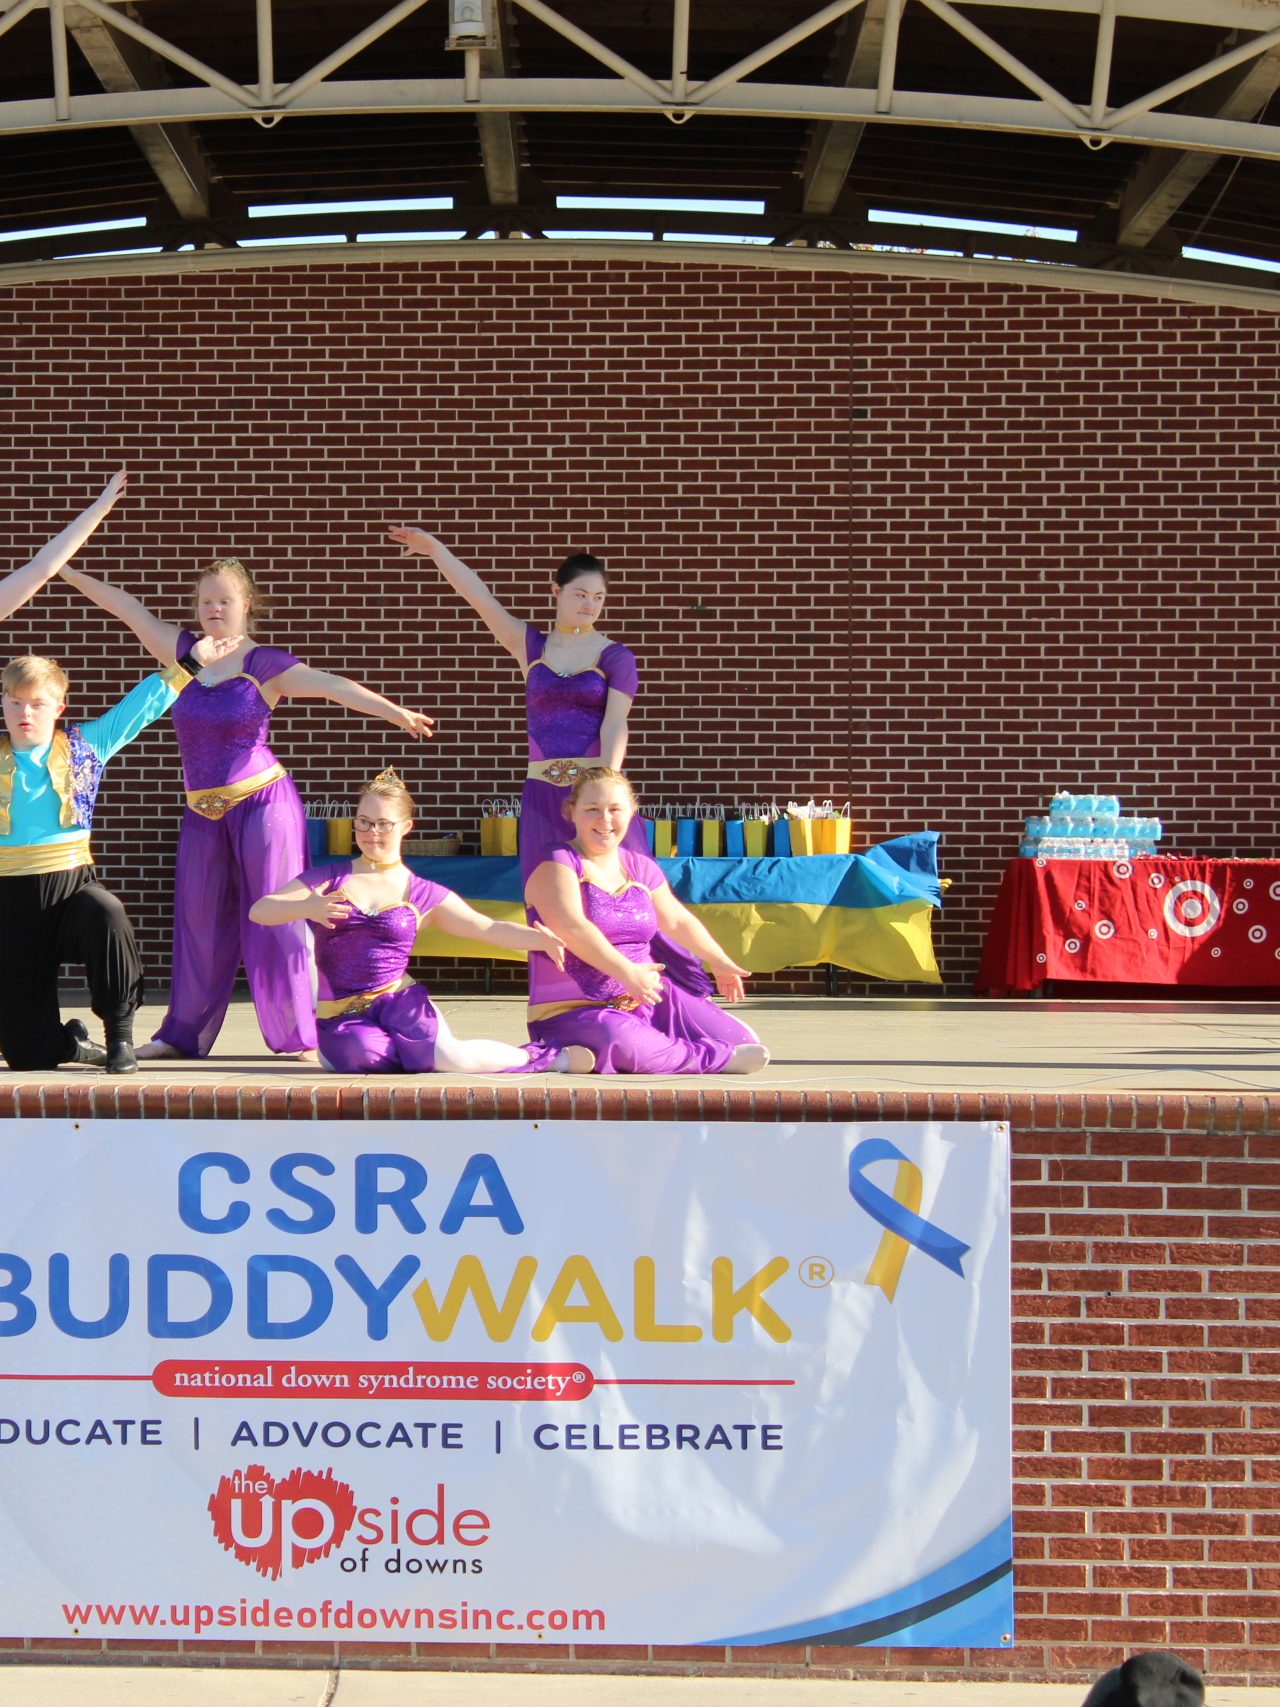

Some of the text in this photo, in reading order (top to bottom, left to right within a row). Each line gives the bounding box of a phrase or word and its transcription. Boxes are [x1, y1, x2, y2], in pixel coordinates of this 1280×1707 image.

[177, 1151, 525, 1236] CSRA
[173, 1365, 274, 1388] national
[280, 1366, 350, 1389] down
[358, 1366, 479, 1395] syndrome
[230, 1420, 464, 1450] ADVOCATE
[532, 1423, 784, 1451] CELEBRATE
[233, 1475, 268, 1494] the
[339, 1547, 483, 1574] of downs
[61, 1598, 608, 1634] www.upsideofdownsinc.com
